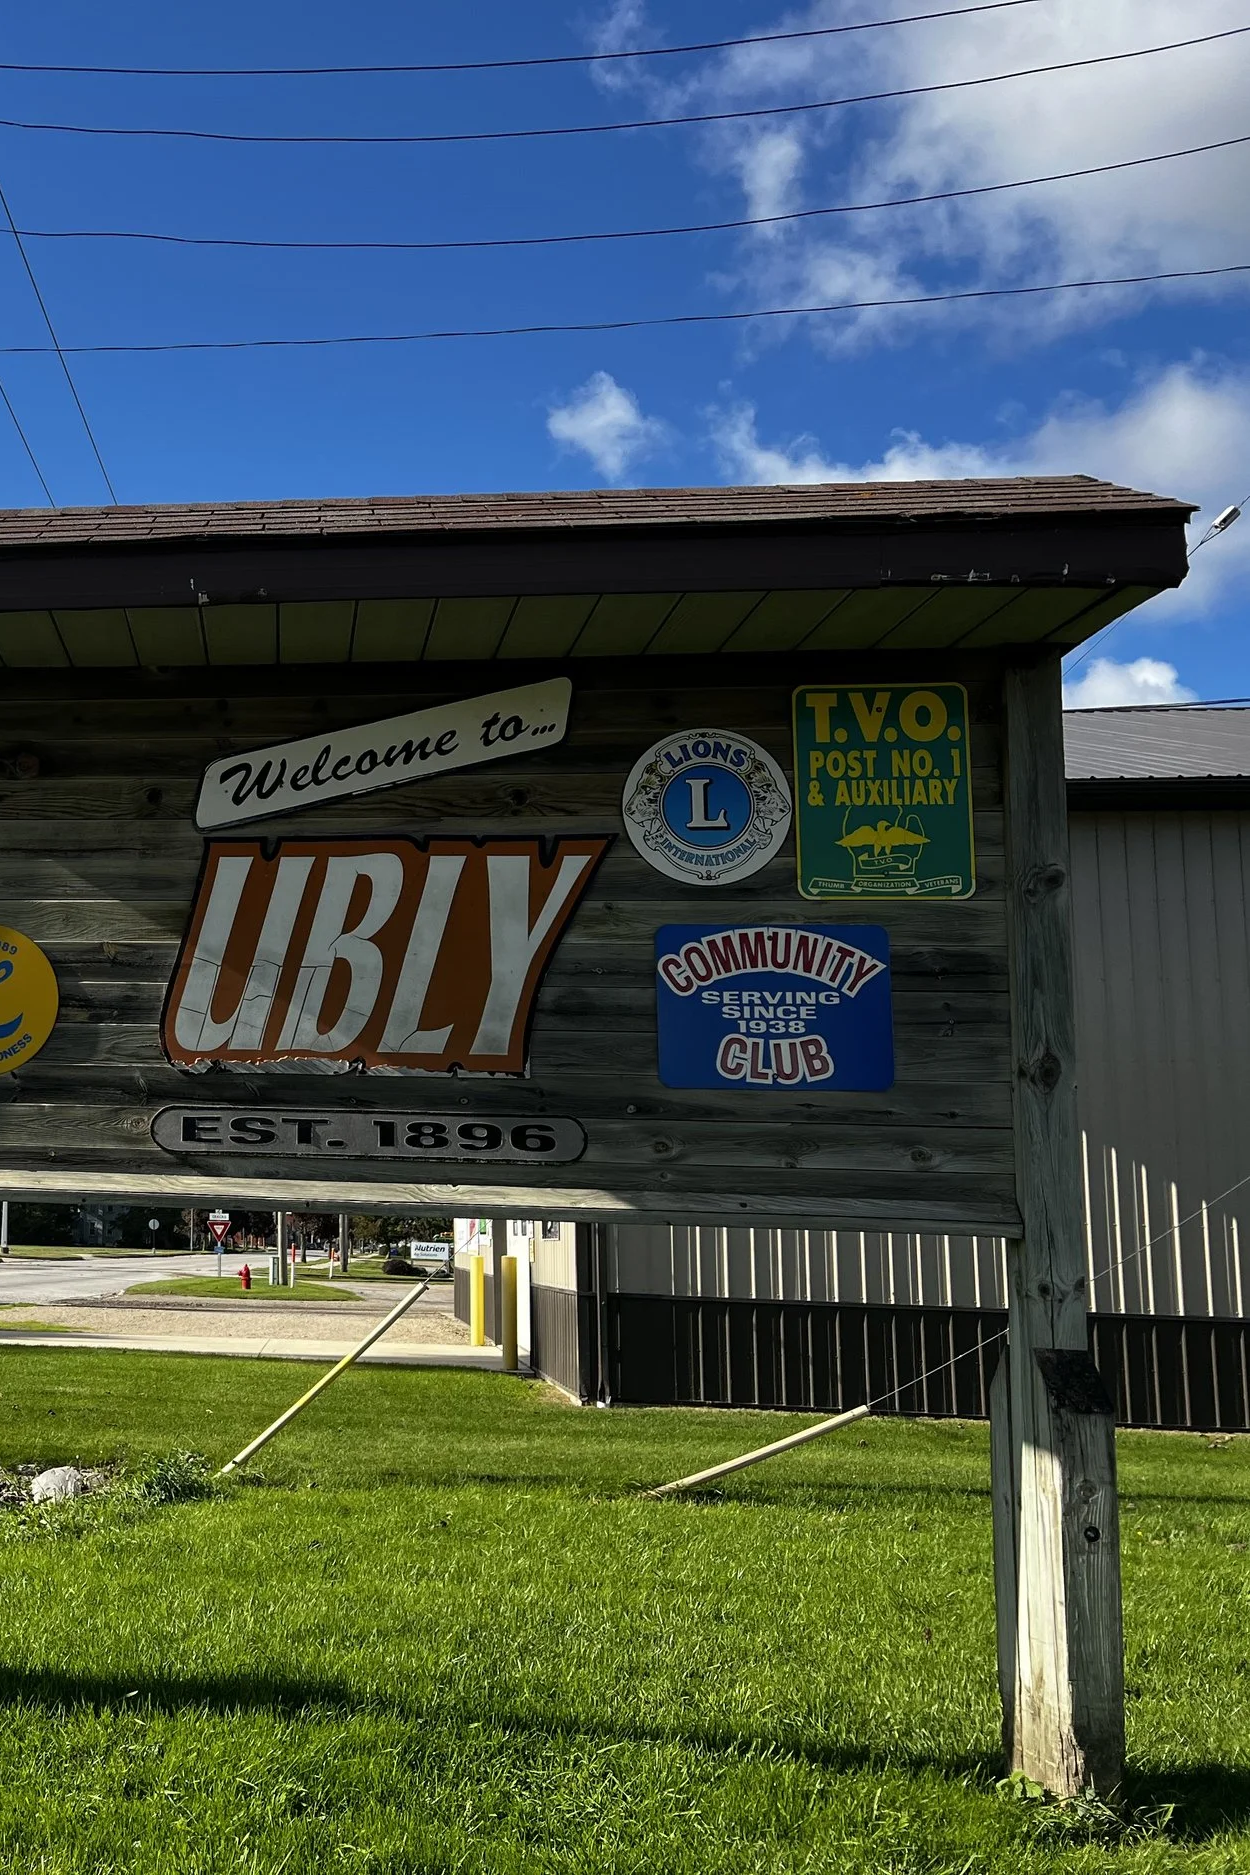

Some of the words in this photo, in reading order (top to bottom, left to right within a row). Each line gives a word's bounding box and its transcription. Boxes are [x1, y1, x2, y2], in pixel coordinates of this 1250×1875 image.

[806, 690, 961, 743] T.V.O.
[218, 728, 459, 806] Welcome
[479, 711, 557, 748] to...
[663, 740, 747, 769] LIONS
[809, 750, 877, 779] POST
[892, 749, 940, 778] NO.
[950, 748, 961, 777] 1
[685, 779, 729, 829] L
[807, 780, 825, 806] &
[835, 778, 958, 806] AUXILIARY
[660, 836, 757, 867] INTERNATIONAL
[818, 881, 845, 889] THUMB
[858, 880, 912, 889] ORGANIZATION
[924, 878, 959, 888] VETERANS
[174, 852, 592, 1056] UBLY
[658, 928, 884, 996] COMMUNITY
[701, 991, 840, 1005] SERVING
[722, 1006, 817, 1019] SINCE
[737, 1020, 806, 1034] 1938
[717, 1035, 833, 1083] CLUB
[180, 1115, 347, 1149] EST.
[372, 1119, 558, 1154] 1896
[415, 1244, 445, 1252] Nutrien
